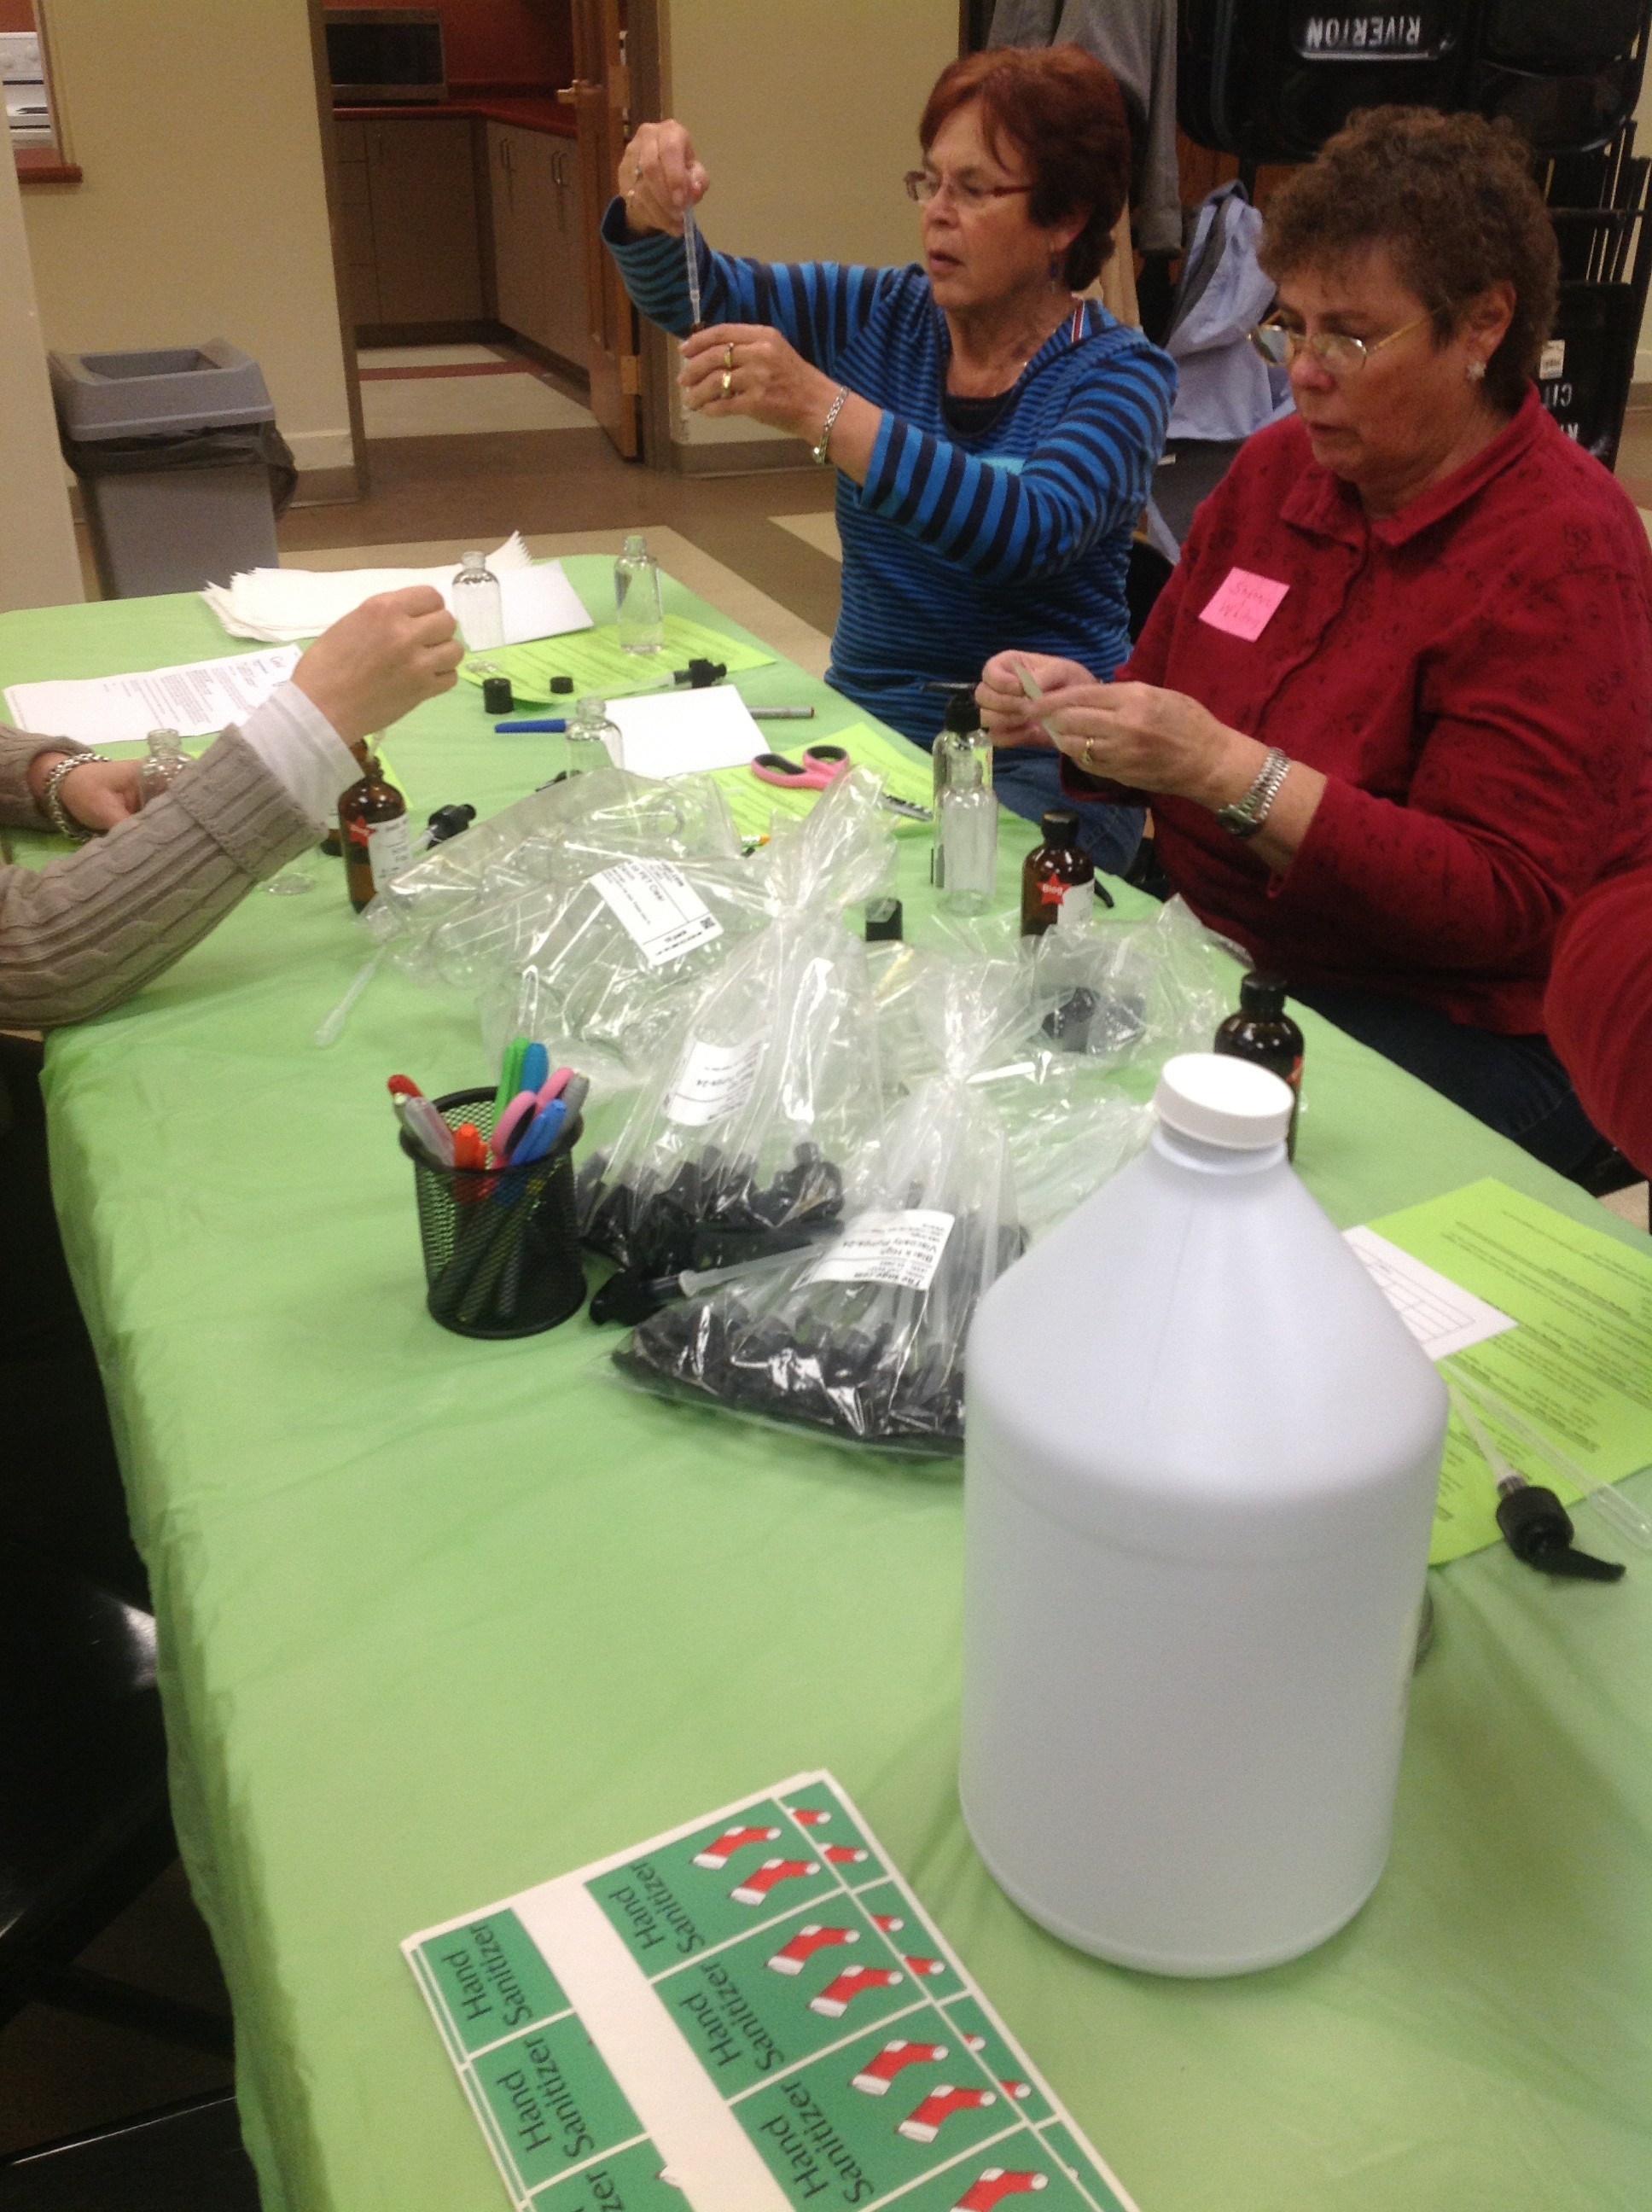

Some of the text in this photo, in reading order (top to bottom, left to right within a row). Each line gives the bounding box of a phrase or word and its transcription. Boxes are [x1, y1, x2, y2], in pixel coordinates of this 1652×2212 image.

[1306, 15, 1422, 47] RIVERTON
[608, 1886, 666, 1950] Hand
[629, 1862, 707, 1954] Sanitizer
[441, 1949, 493, 2021] Hand
[469, 1924, 533, 2027] Sanitizer
[700, 1962, 785, 2071] Sanitizer
[679, 1992, 742, 2067] Hand
[496, 2069, 553, 2153] Hand
[522, 2037, 596, 2158] Sanitizer
[759, 2114, 829, 2199] Hand
[780, 2081, 875, 2203] Sanitizer
